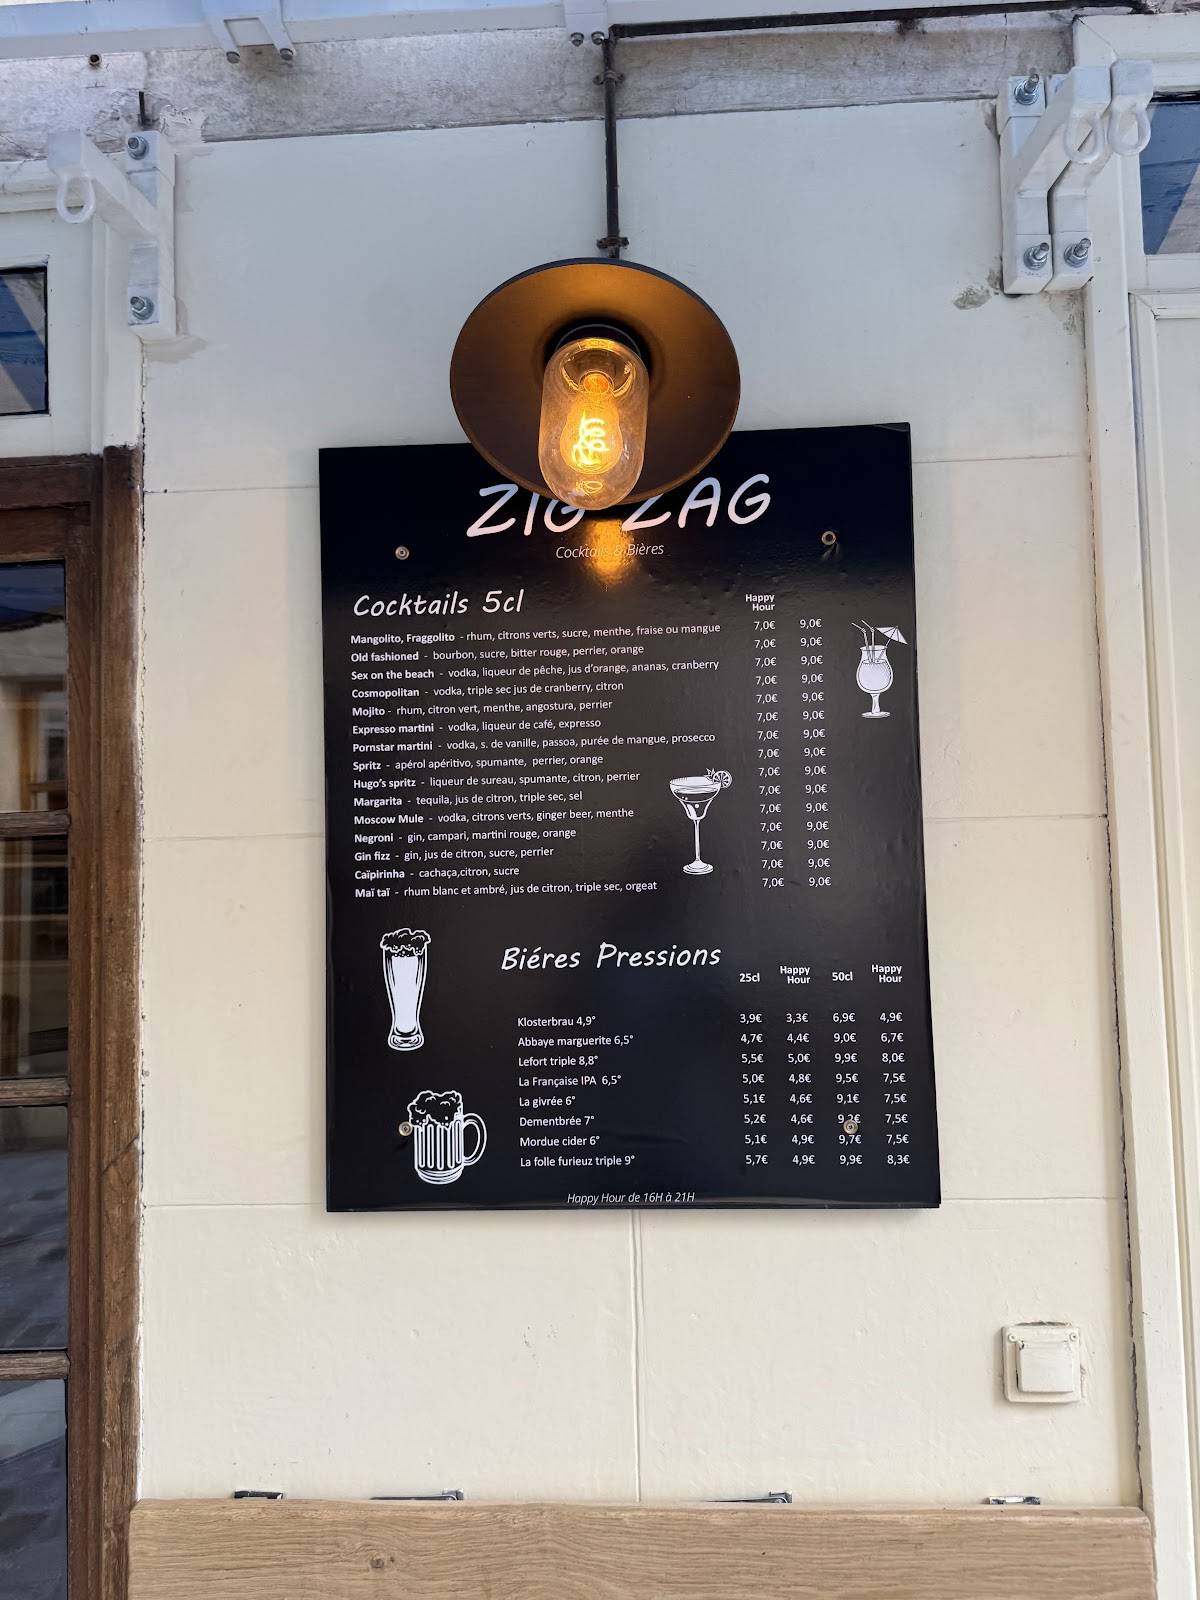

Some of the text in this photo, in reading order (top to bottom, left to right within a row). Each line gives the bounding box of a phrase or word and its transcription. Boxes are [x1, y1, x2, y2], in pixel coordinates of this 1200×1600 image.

[466, 473, 771, 538] ZIG ZAG
[626, 543, 665, 557] Bières
[353, 588, 524, 616] Cocktails 5cl
[745, 593, 775, 603] Happy
[752, 602, 775, 611] Hour
[753, 620, 776, 631] 7,0€
[799, 618, 822, 629] 9,0€
[350, 633, 404, 645] Mangolito,
[406, 632, 455, 644] Fraggolito
[466, 631, 495, 641] rhum,
[497, 630, 530, 640] citrons
[532, 629, 559, 639] verts,
[561, 629, 590, 638] sucre,
[593, 626, 634, 636] menthe,
[636, 625, 663, 635] fraise
[680, 624, 720, 634] mangue
[754, 638, 776, 650] 7,0€
[800, 636, 822, 648] 9,0€
[350, 645, 644, 662] Old fashioned bourbon, sucre, bitter rouge, perrier, orange
[755, 693, 778, 704] 7,0€
[801, 691, 824, 703] 9,0€
[351, 699, 613, 717] Mojito rhum, citron vert, menthe, angostura, perrier
[756, 711, 778, 723] 7,0€
[802, 709, 824, 721] 9,0€
[352, 719, 601, 736] Expresso martini vodka, liqueur de café, expresso
[757, 748, 779, 759] 7,0€
[803, 746, 826, 757] 9,0€
[352, 755, 603, 772] Spritz apérol apéritivo, spumante, perrier, orange
[759, 803, 781, 814] 7,0€
[805, 802, 828, 813] 9,0€
[353, 807, 634, 824] Moscow Mule vodka, citrons verts, ginger beer, menthe
[759, 821, 782, 833] 7,0€
[806, 820, 829, 832] 9,0€
[354, 829, 576, 844] Negroni gin, campari, martini rouge, orange
[761, 858, 783, 870] 7,0€
[807, 857, 830, 869] 9,0€
[493, 867, 519, 875] sucre
[500, 941, 721, 970] Biéres Pressions
[779, 965, 810, 976] Happy
[831, 970, 853, 981] 50cl
[871, 964, 902, 975] Happy
[739, 972, 760, 982] 25cl
[786, 975, 810, 984] Hour
[878, 974, 903, 983] Hour
[517, 1016, 573, 1026] Klosterbrau
[739, 1013, 762, 1024] 3,9€
[785, 1012, 808, 1024] 3,3€
[832, 1012, 855, 1023] 6,9€
[879, 1011, 903, 1023] 4,9€
[517, 1036, 554, 1048] Abbaye
[556, 1035, 611, 1047] marguerite
[740, 1033, 763, 1045] 4,7€
[786, 1032, 809, 1044] 4,4€
[833, 1032, 856, 1044] 9,0€
[880, 1032, 904, 1043] 6,7€
[518, 1056, 547, 1066] Lefort
[549, 1055, 576, 1067] triple
[741, 1053, 764, 1064] 5,5€
[787, 1052, 811, 1064] 5,0€
[834, 1052, 857, 1064] 9,9€
[881, 1052, 905, 1064] 8,0€
[518, 1076, 529, 1086] La
[532, 1075, 578, 1088] Française
[580, 1075, 597, 1085] IPA
[742, 1073, 765, 1085] 5,0€
[788, 1073, 811, 1084] 4,8€
[835, 1072, 858, 1084] 9,5€
[882, 1072, 906, 1084] 7,5€
[519, 1096, 530, 1106] La
[532, 1095, 563, 1108] givrée
[743, 1093, 765, 1105] 5,1€
[789, 1093, 812, 1105] 4,6€
[836, 1093, 860, 1104] 9,1€
[883, 1093, 907, 1104] 7,5€
[519, 1115, 581, 1126] Dementbrée
[743, 1113, 766, 1125] 5,2€
[790, 1113, 813, 1125] 4,6€
[884, 1113, 908, 1125] 7,5€
[519, 1135, 559, 1146] Mordue
[561, 1135, 587, 1146] cider
[744, 1134, 767, 1145] 5,1€
[791, 1134, 814, 1145] 4,9€
[838, 1134, 862, 1146] 9,7€
[885, 1133, 909, 1145] 7,5€
[520, 1157, 531, 1167] La
[533, 1156, 556, 1166] folle
[557, 1155, 593, 1166] furieuz
[594, 1154, 622, 1167] triple
[745, 1154, 768, 1166] 5,7€
[791, 1154, 815, 1166] 4,9€
[839, 1154, 863, 1166] 9,9€
[886, 1154, 910, 1165] 8,3€
[566, 1191, 696, 1205] Happy Hour de 16H à 21H
